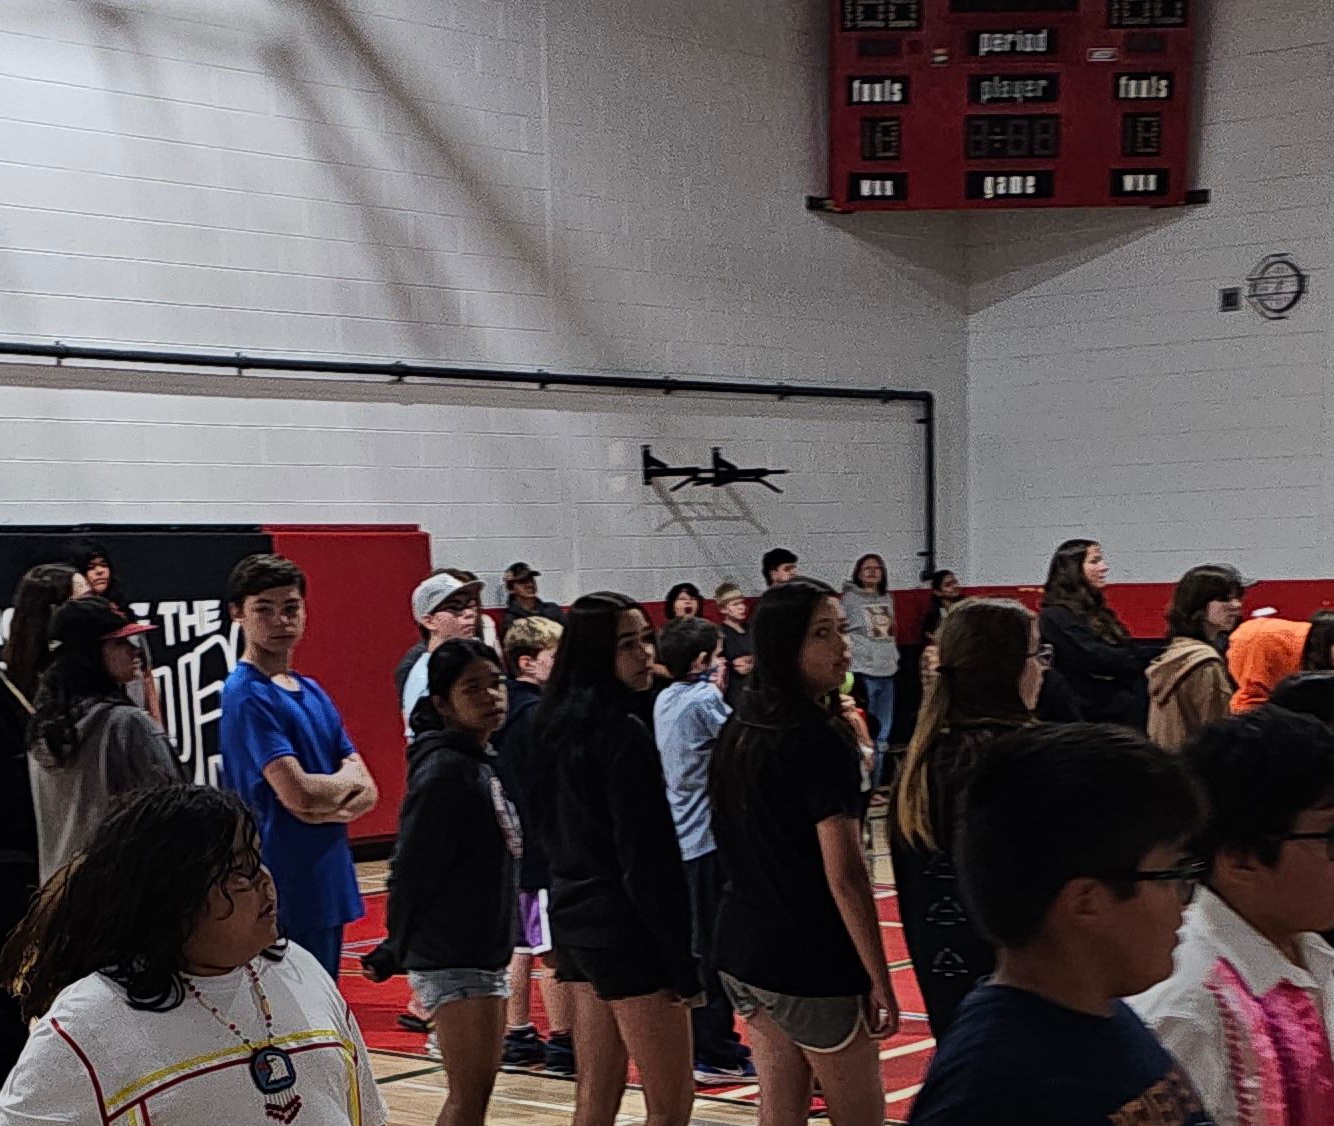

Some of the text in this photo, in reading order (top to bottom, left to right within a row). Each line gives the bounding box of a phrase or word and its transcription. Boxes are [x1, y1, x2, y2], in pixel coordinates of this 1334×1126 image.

[978, 28, 1048, 56] period
[851, 79, 903, 102] fouls
[980, 76, 1049, 104] player
[1118, 76, 1169, 99] fouls
[156, 599, 222, 647] THE
